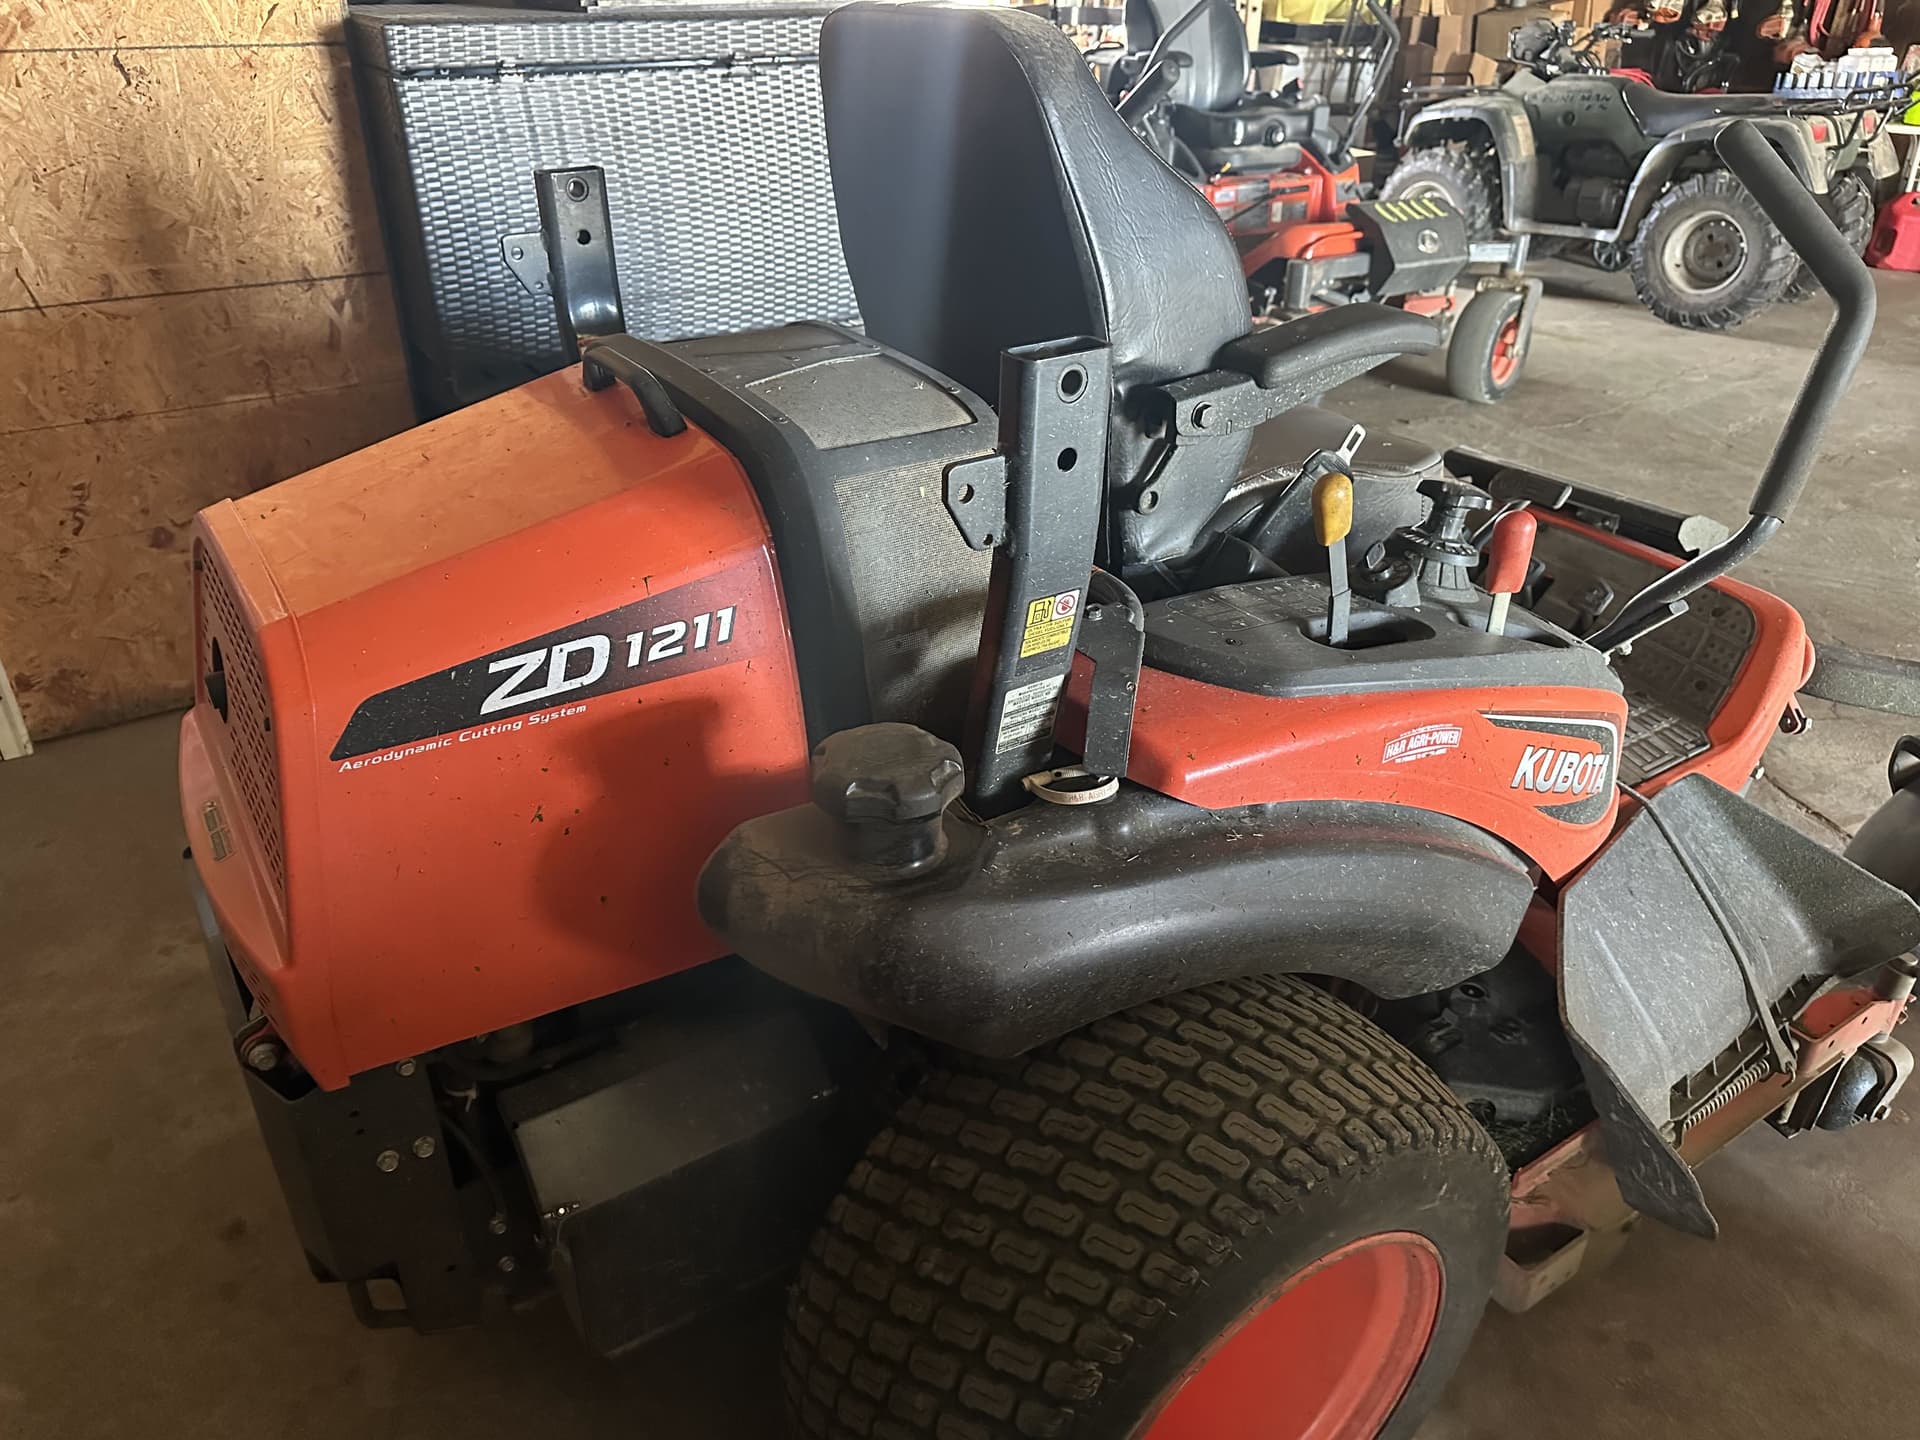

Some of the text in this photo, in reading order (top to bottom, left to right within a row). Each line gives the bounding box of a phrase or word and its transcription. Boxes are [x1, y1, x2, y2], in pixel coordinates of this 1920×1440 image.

[480, 606, 735, 715] ZD 1211
[339, 704, 587, 773] Aerodynamic Cutting System
[1386, 739, 1407, 759] H&R
[1407, 730, 1460, 751] AGRI-POWER
[1511, 745, 1610, 795] KUBOTA
